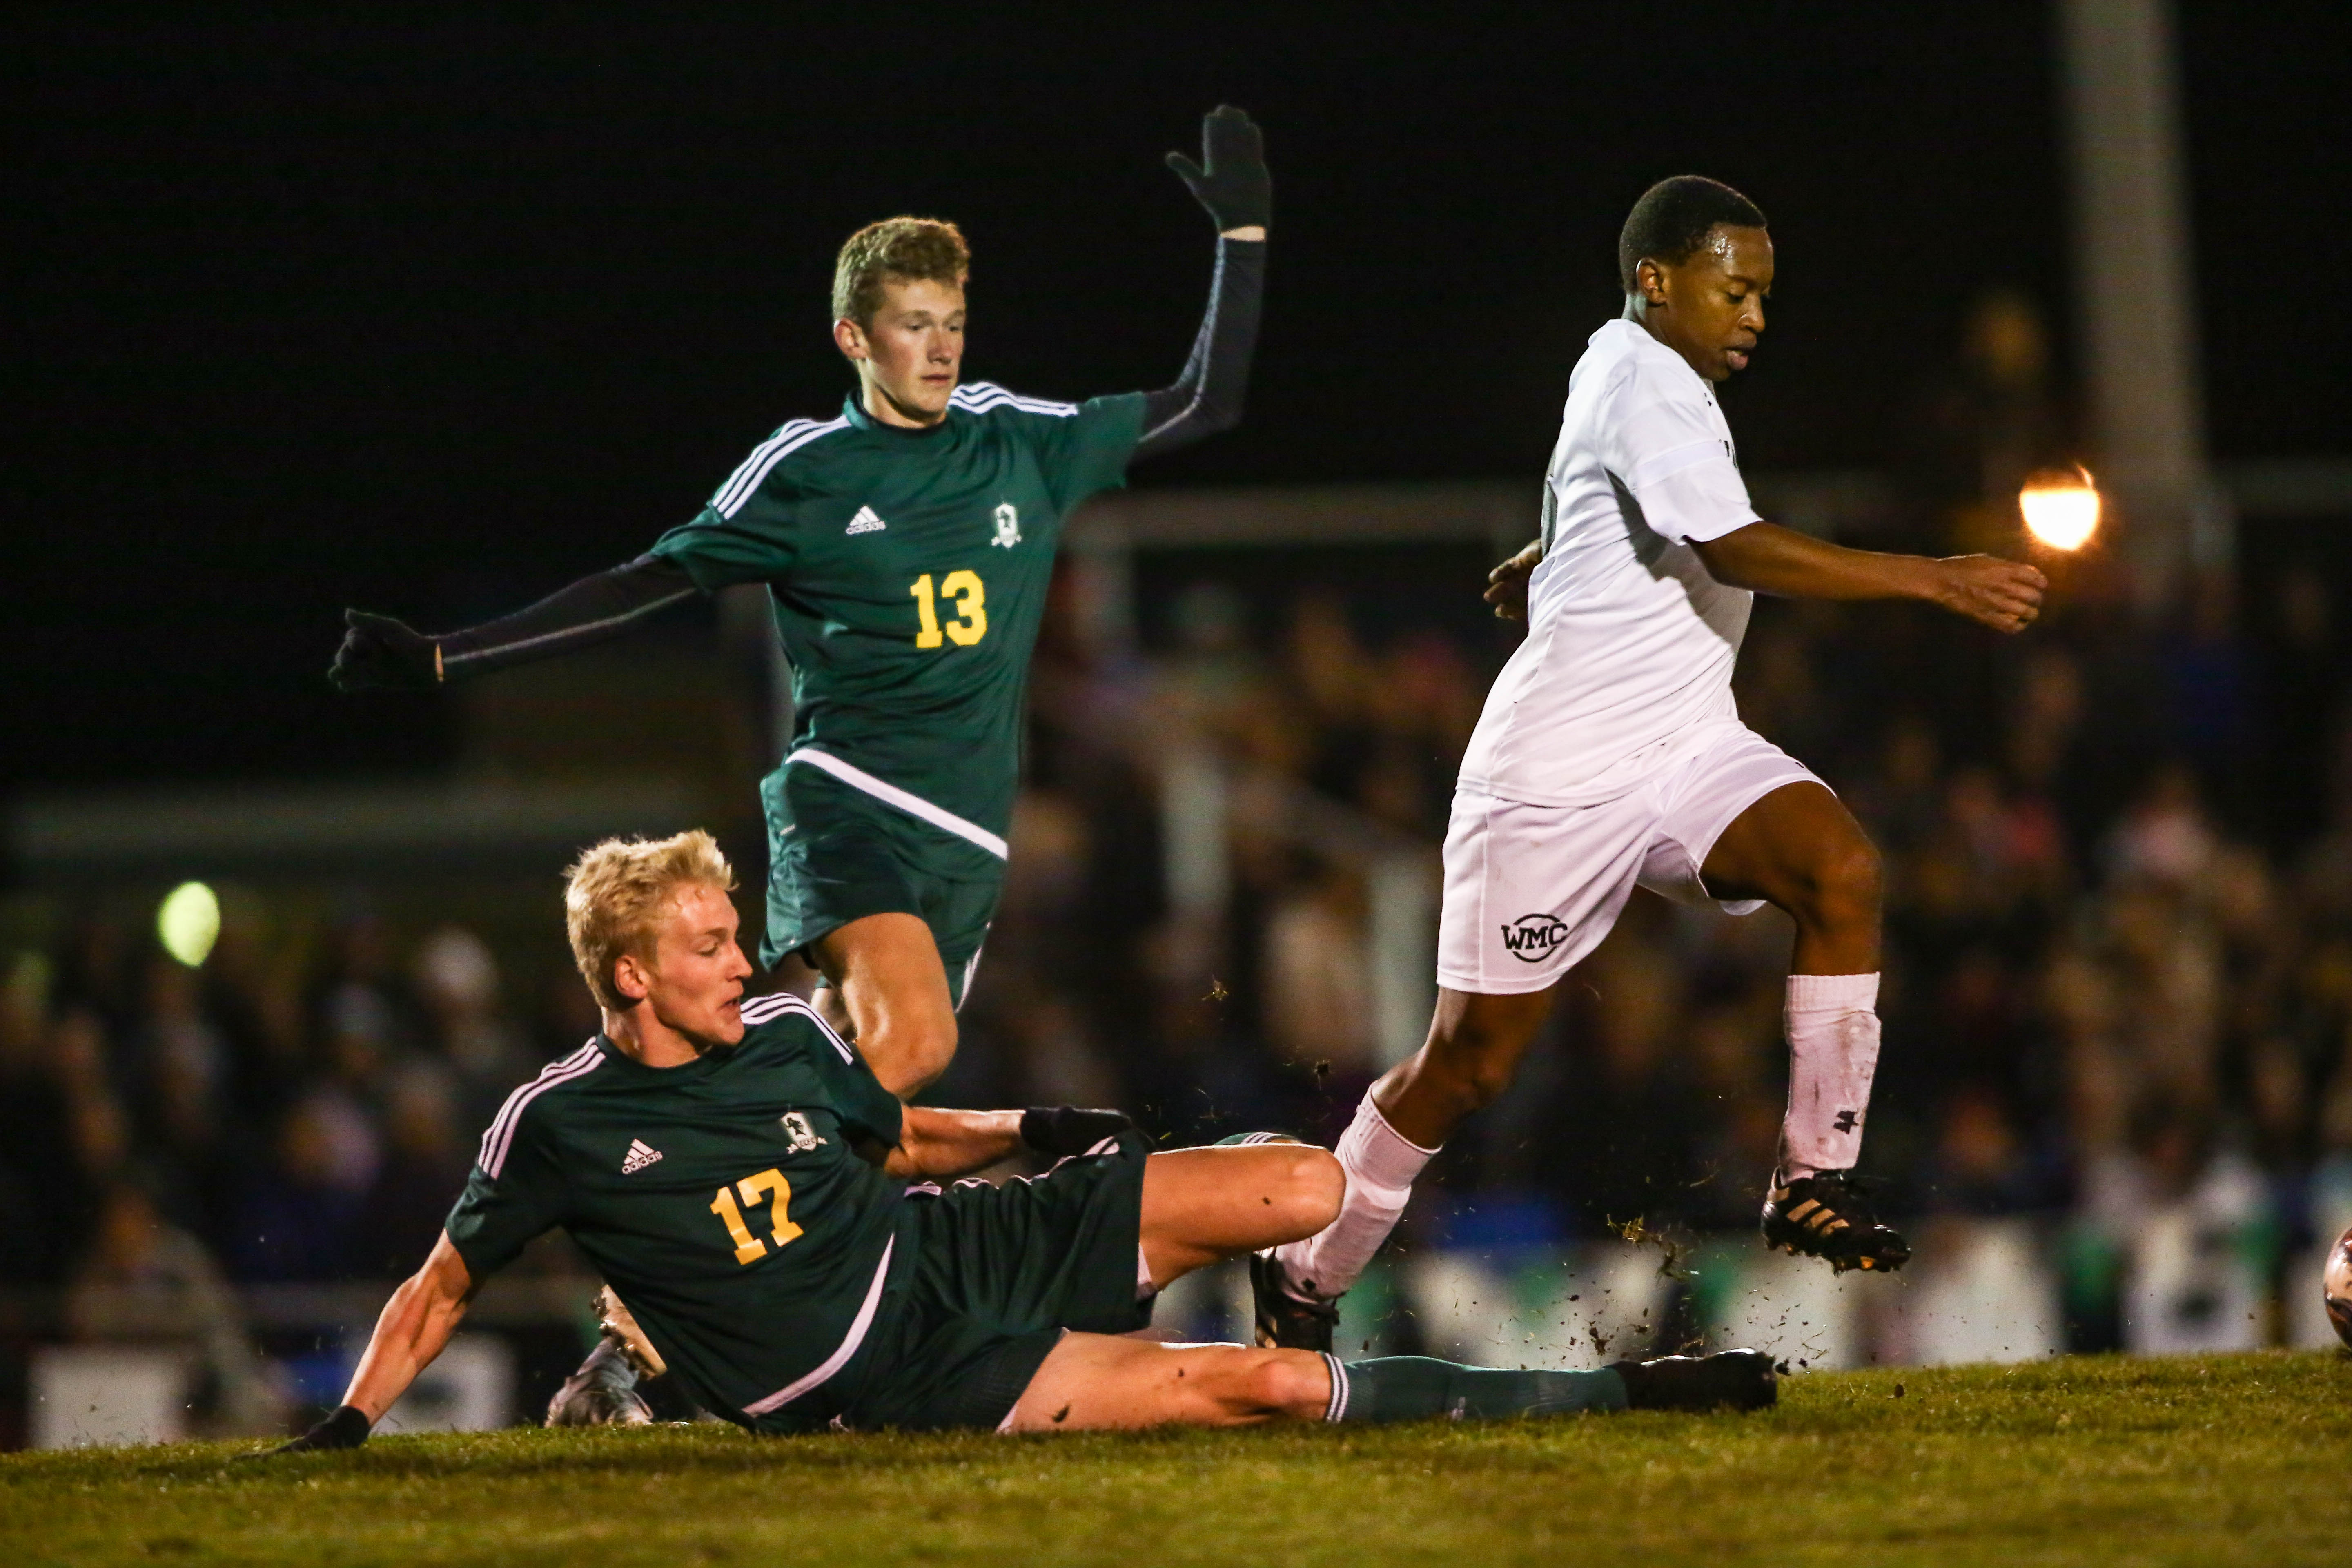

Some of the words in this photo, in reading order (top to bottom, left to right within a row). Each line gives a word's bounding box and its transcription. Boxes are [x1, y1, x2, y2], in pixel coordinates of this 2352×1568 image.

[910, 570, 988, 648] 13
[1501, 922, 1568, 949] WMC
[621, 1151, 663, 1175] adidas
[709, 1168, 804, 1266] 17
